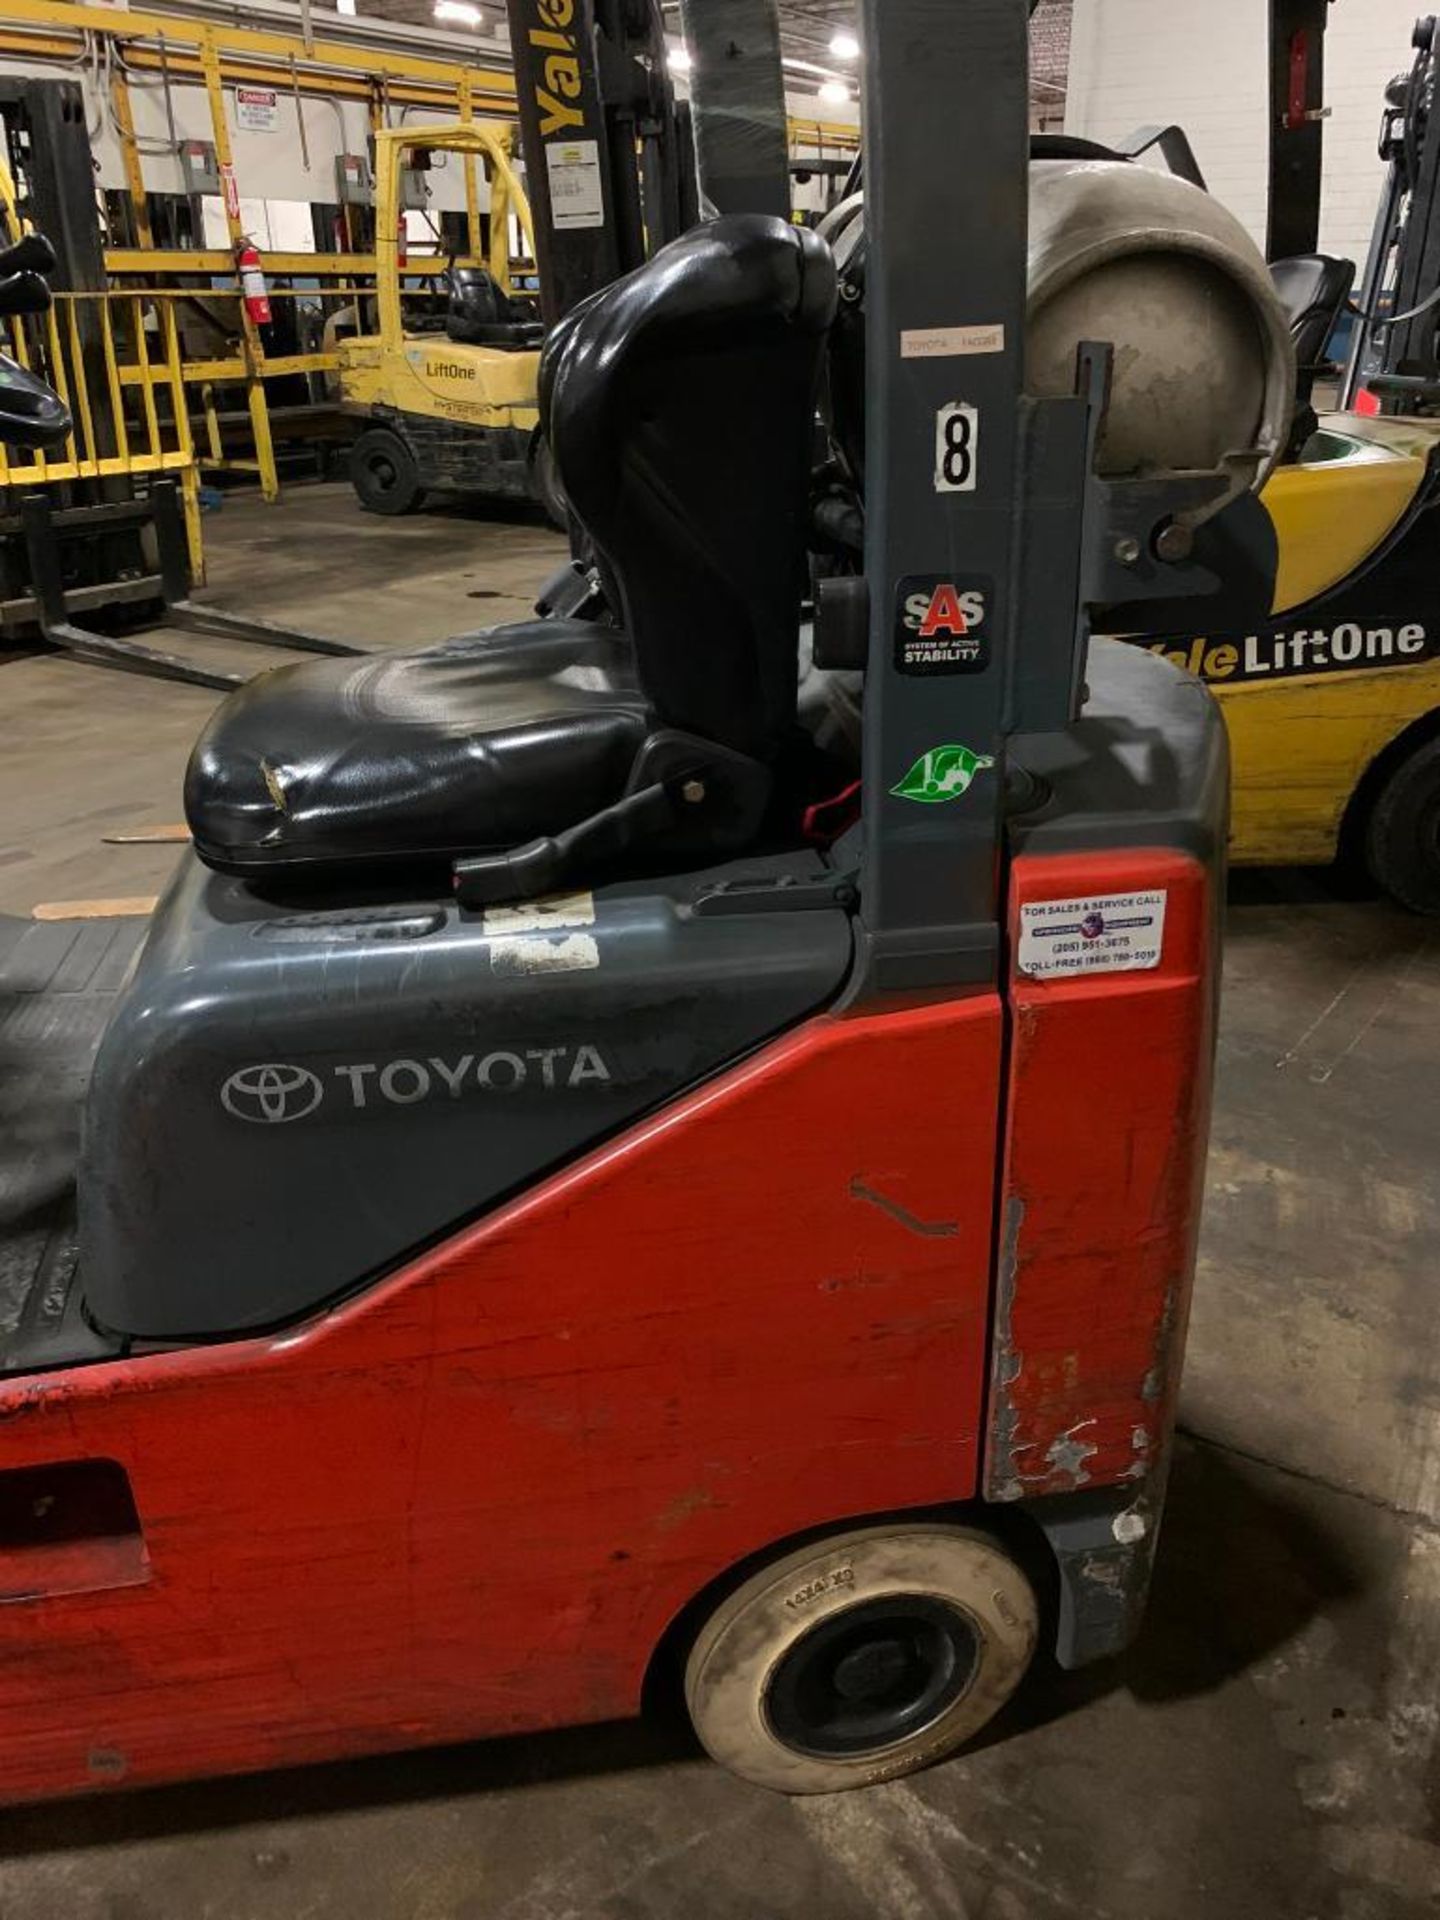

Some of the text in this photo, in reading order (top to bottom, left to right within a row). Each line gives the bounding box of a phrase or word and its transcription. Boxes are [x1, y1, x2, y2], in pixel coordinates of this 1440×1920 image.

[529, 0, 585, 136] Yale
[426, 362, 476, 380] LiftOne
[943, 414, 971, 486] 8
[903, 583, 985, 636] SAS
[904, 639, 980, 651] SYSTEM OF ACTIVE
[904, 648, 980, 663] STABILITY
[1244, 622, 1426, 673] LiftOne
[1024, 895, 1162, 917] FOR SALES & SERVICE CALL
[1025, 957, 1083, 972] TOLL-FREE
[334, 1044, 611, 1107] TOYOTA
